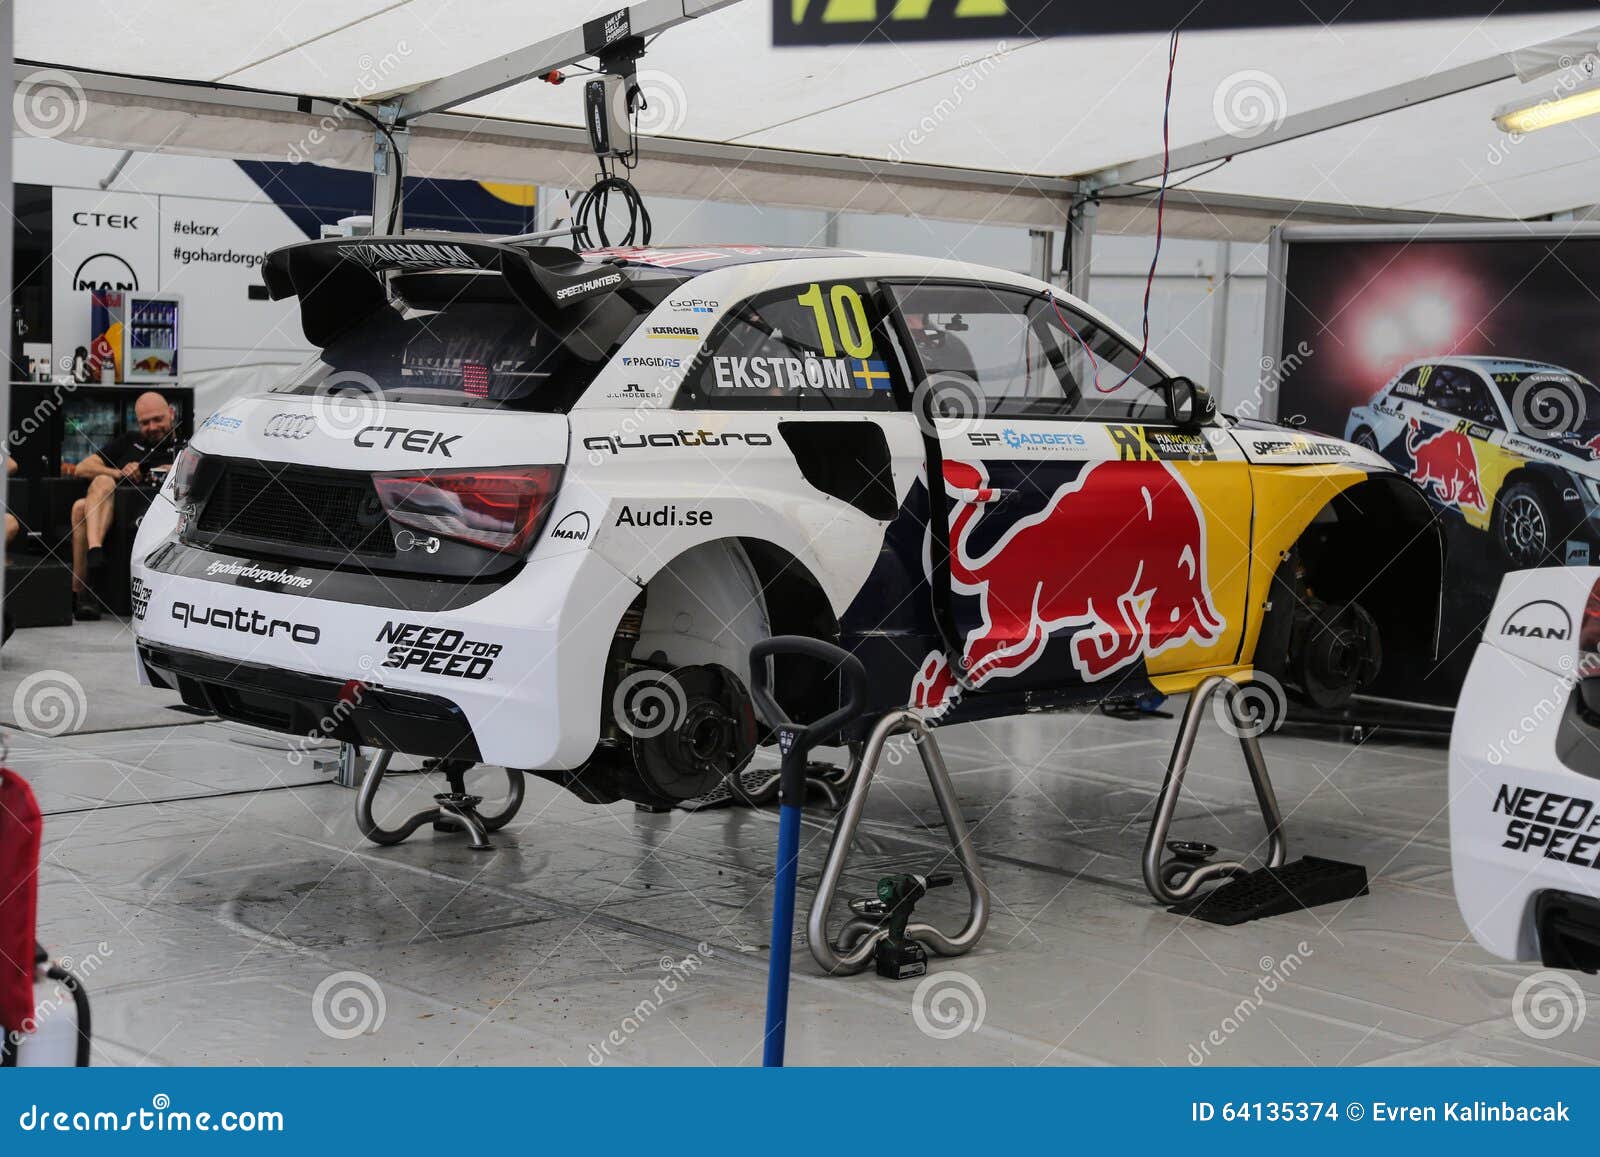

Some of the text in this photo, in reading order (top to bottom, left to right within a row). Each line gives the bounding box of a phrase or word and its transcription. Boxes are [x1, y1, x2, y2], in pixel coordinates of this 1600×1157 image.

[72, 212, 139, 230] CTEK
[173, 220, 220, 236] #eksrx
[368, 244, 477, 263] MAXIMUM
[556, 273, 622, 300] SPEEDHUNTERS
[669, 299, 719, 308] GoPro
[797, 283, 874, 360] 10
[712, 350, 851, 389] EKSTRÖM
[1416, 366, 1433, 389] 10
[353, 425, 463, 458] CTEK
[583, 429, 773, 455] quattro
[1002, 427, 1086, 449] GADGETS
[615, 505, 713, 527] Audi.se
[554, 529, 587, 541] MAN
[206, 560, 313, 589] #gohardorgohome
[171, 601, 321, 645] quattro
[1507, 624, 1566, 640] MAN
[375, 620, 503, 659] NEED FOR
[381, 645, 498, 681] SPEED
[1492, 783, 1594, 830] NEED
[1502, 820, 1600, 870] SPEE
